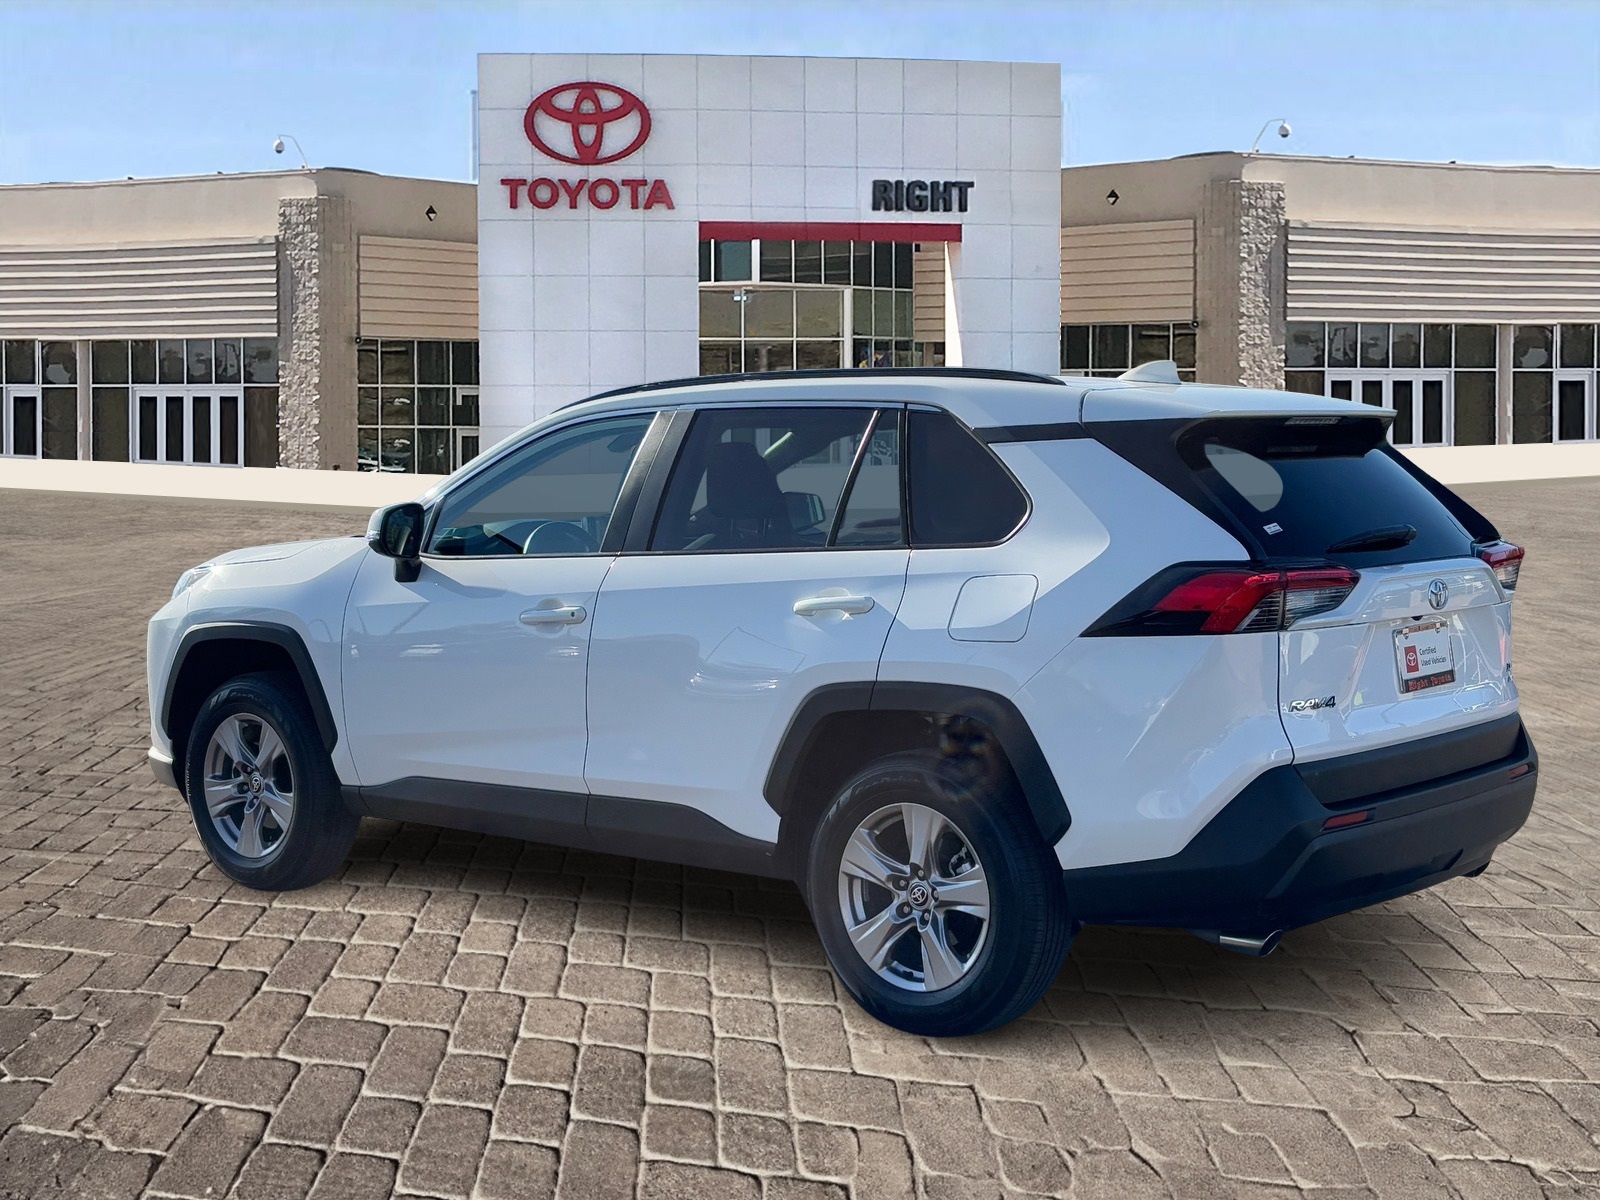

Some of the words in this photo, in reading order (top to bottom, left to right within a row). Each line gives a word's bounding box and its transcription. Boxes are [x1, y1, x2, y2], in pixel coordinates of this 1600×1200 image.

[500, 177, 675, 210] TOYOTA
[871, 179, 975, 213] RIGHT
[1419, 646, 1436, 655] Certified
[1421, 657, 1431, 666] Used
[1431, 656, 1446, 665] Vehicles
[1288, 695, 1336, 712] RAV4
